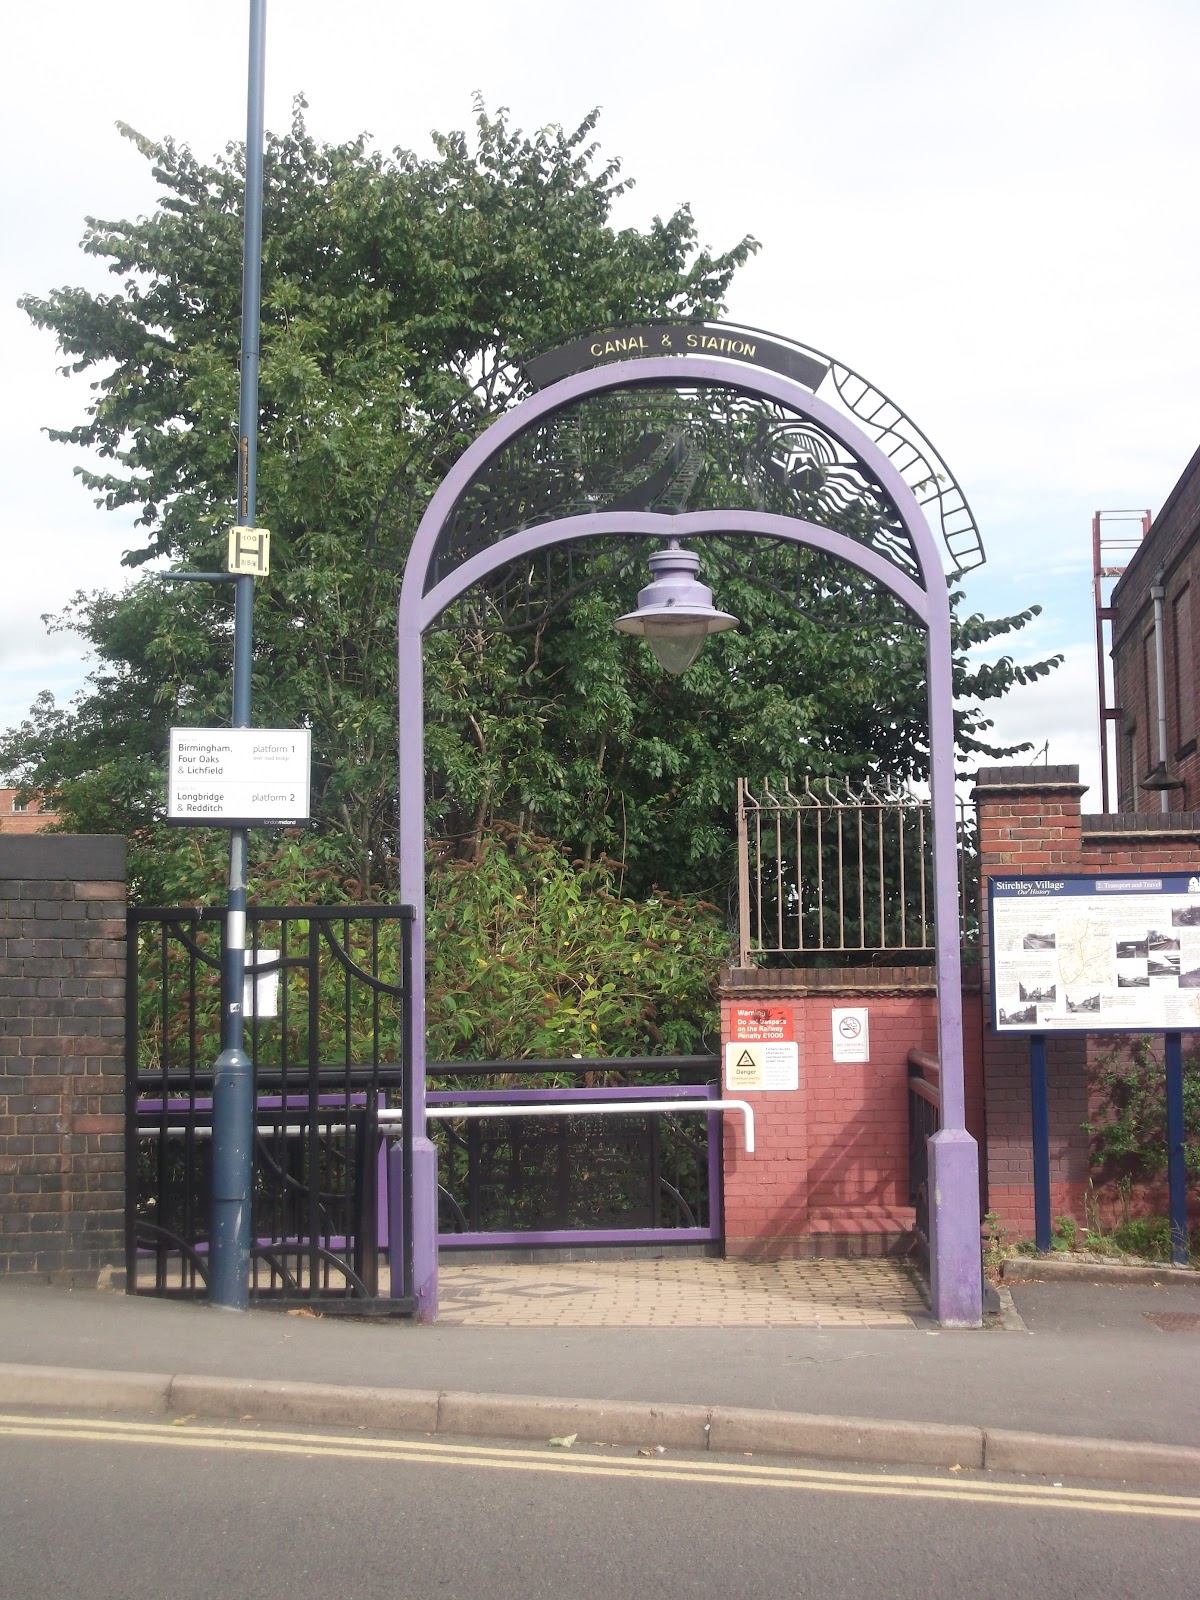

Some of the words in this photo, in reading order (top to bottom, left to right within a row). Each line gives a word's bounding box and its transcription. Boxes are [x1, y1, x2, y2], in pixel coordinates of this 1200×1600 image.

[590, 335, 649, 358] CANAL
[661, 333, 672, 347] &
[686, 333, 756, 358] STATION
[178, 743, 233, 755] Birmingham,
[253, 744, 288, 755] platform
[291, 745, 295, 753] 1
[178, 755, 197, 763] Four
[199, 754, 220, 763] Oaks
[178, 766, 184, 775] &
[187, 766, 223, 775] Lichfield
[177, 792, 225, 803] Longbridge
[252, 793, 287, 804] platform
[290, 793, 295, 802] 2
[177, 803, 183, 812] &
[186, 803, 223, 812] Redditch
[996, 880, 1033, 891] Stirchley
[1035, 880, 1065, 891] Village
[1104, 882, 1131, 890] Transport
[1029, 888, 1050, 896] History
[736, 1068, 756, 1076] Danger
